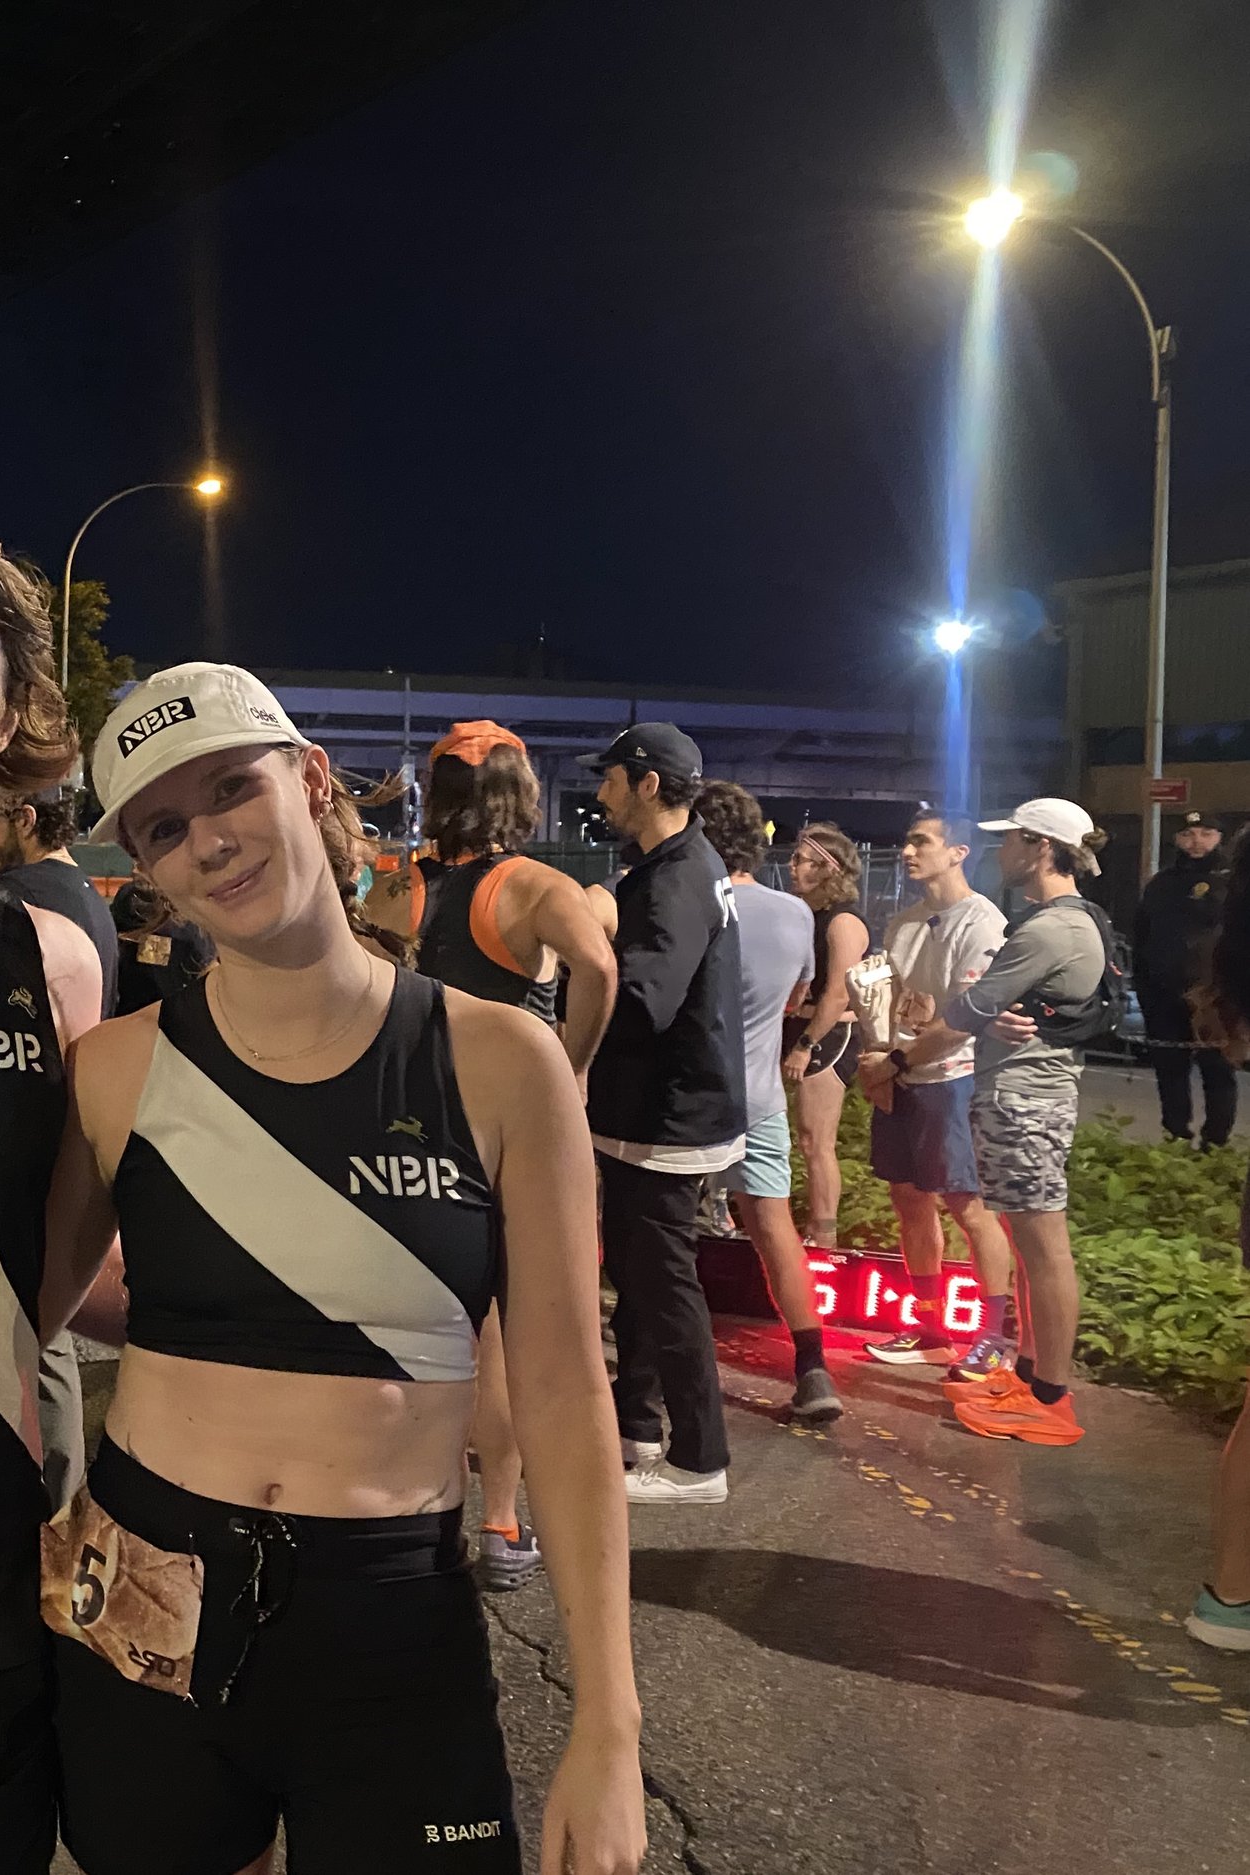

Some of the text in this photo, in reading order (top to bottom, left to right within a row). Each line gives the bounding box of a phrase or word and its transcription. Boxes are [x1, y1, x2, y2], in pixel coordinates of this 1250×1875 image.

[122, 701, 188, 752] NBR
[349, 1155, 462, 1200] NBR
[71, 1542, 107, 1626] 5
[444, 1820, 501, 1842] BANDIT
